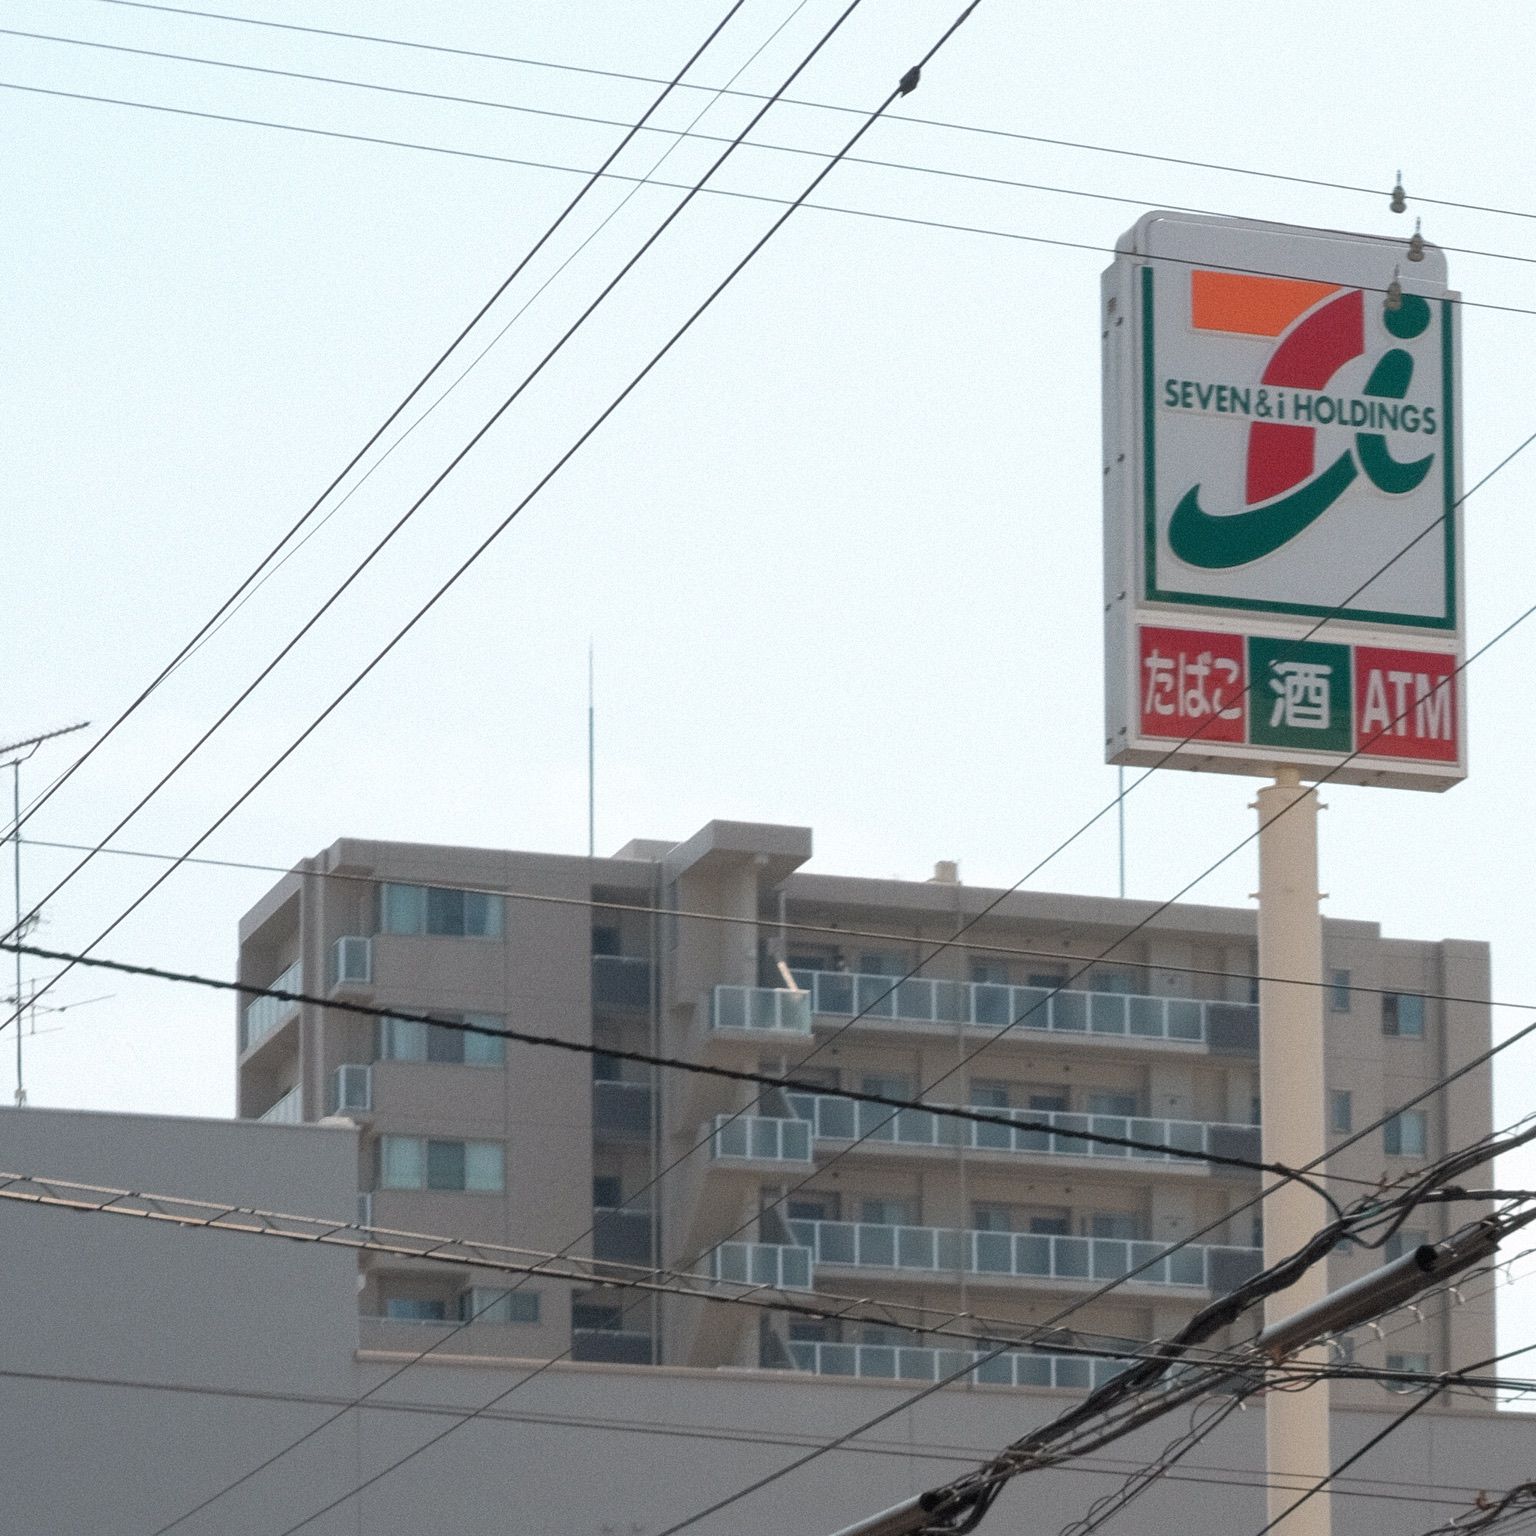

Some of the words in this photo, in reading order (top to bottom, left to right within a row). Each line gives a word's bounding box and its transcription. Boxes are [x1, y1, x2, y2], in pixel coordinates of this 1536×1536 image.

[1165, 378, 1285, 420] SEVEN&i
[1294, 394, 1437, 436] HOLDINGS
[1144, 649, 1245, 719] たばこ
[1268, 659, 1333, 729] 酒
[1361, 668, 1453, 741] ATM
